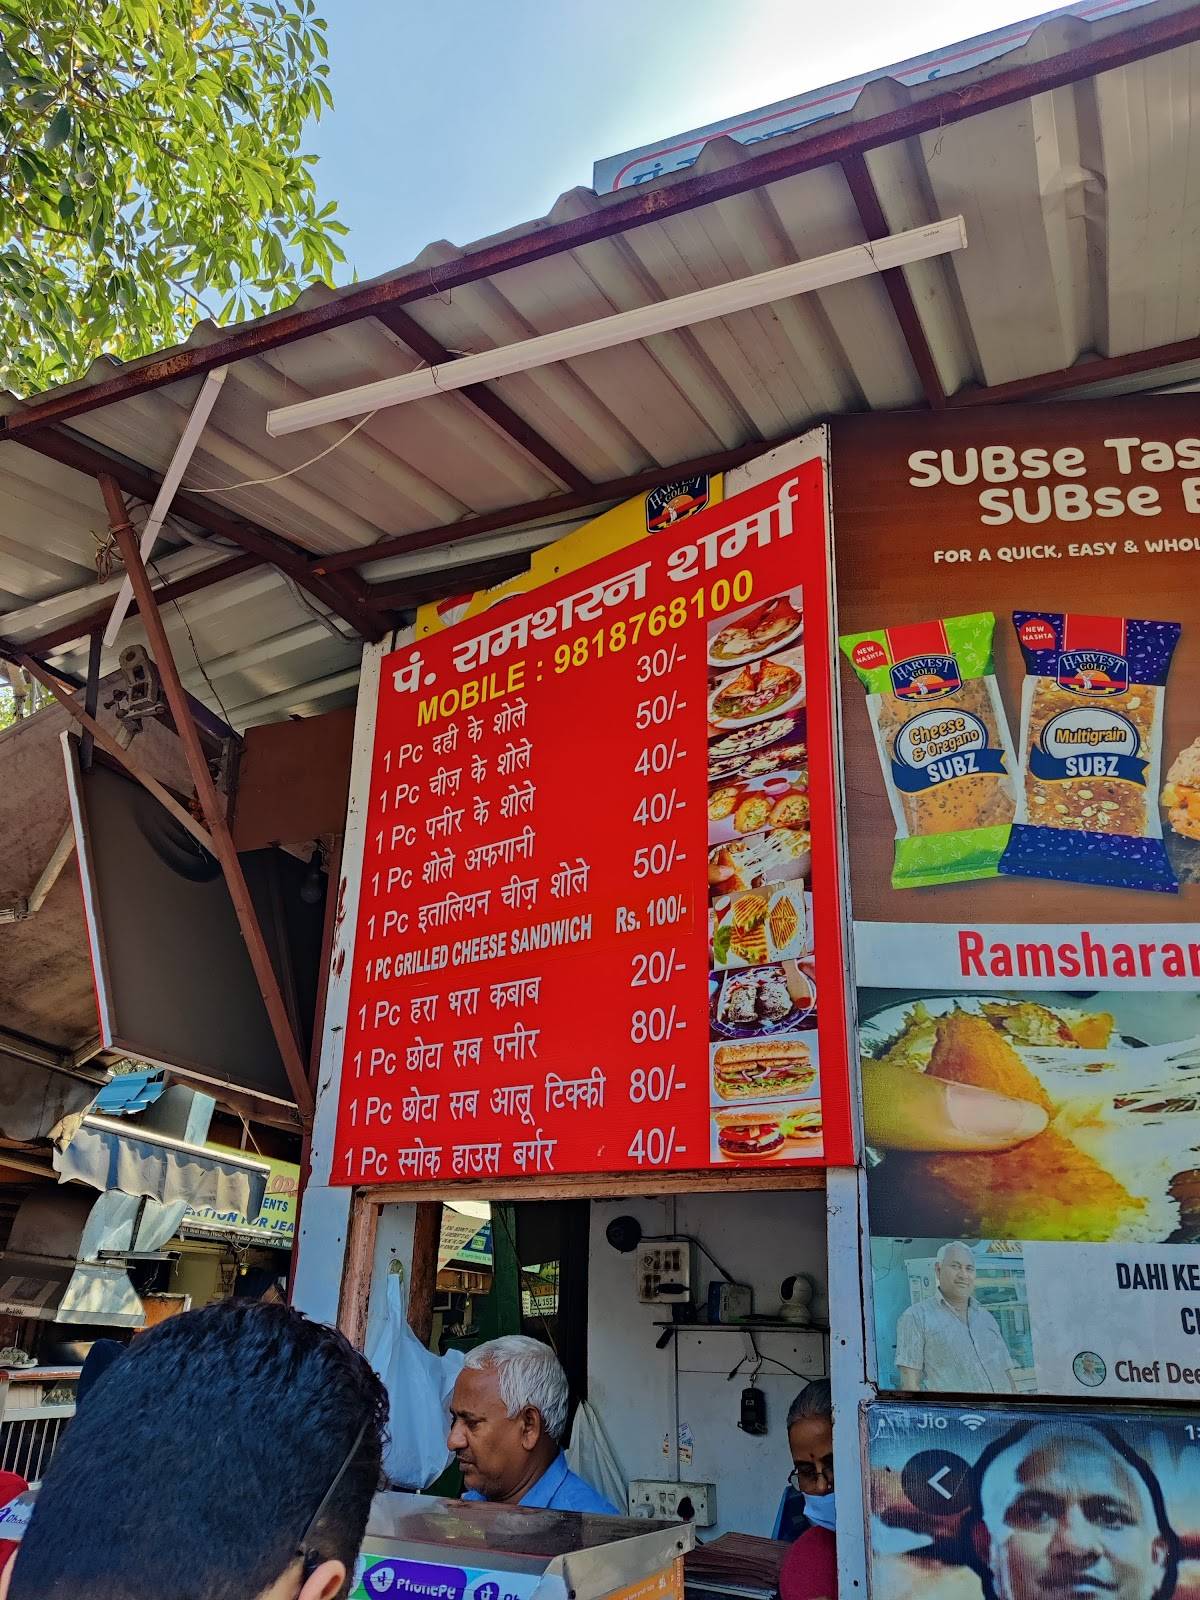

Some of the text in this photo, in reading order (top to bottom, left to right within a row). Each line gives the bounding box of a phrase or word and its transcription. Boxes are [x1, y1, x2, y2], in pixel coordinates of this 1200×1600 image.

[907, 445, 1087, 488] SUBse
[665, 485, 689, 502] GOLD
[978, 483, 1162, 526] SUBse
[933, 549, 972, 564] FOR
[978, 548, 992, 562] A
[997, 545, 1063, 564] QUICK,
[1068, 542, 1118, 558] EASY
[1124, 540, 1139, 553] &
[452, 561, 652, 673] रामशरन
[666, 477, 799, 584] शर्मा
[417, 660, 526, 728] MOBILE
[554, 569, 754, 674] 9818768100
[1022, 631, 1053, 641] NASHTA
[1025, 625, 1045, 633] NEW
[636, 642, 687, 683] 30/-
[855, 650, 885, 664] NASHTA
[856, 645, 875, 656] NEW
[892, 658, 953, 681] HARVEST
[1062, 653, 1125, 675] HARVEST
[1079, 662, 1107, 672] GOLD
[911, 668, 937, 677] GOLD
[635, 689, 687, 730] 50/-
[384, 697, 529, 774] 1 Pc दही के शोले
[908, 717, 965, 745] Cheese
[912, 728, 980, 763] & Oregano
[1055, 727, 1127, 746] Multigrain
[380, 738, 533, 814] 1 Pc चीज़ के शोले
[634, 738, 687, 776] 40/-
[926, 755, 980, 785] SUBZ
[1065, 756, 1120, 777] SUBZ
[375, 780, 537, 854] 1 Pc पनीर के शोले
[632, 788, 687, 827] 40/-
[372, 825, 536, 897] 1 Pc शोले अफगानी
[632, 839, 687, 880] 50/-
[367, 857, 591, 941] 1 Pc इतालियन चीज़ शोले
[614, 894, 687, 934] Rs. 100/-
[365, 913, 592, 983] 1 PC GRILLED CHEESE SANDWICH
[630, 947, 687, 988] 20/-
[358, 976, 542, 1031] 1 Pc हरा भरा कबाब
[630, 1004, 687, 1045] 80/-
[353, 1021, 541, 1079] 1 Pc छोटा सब पनीर
[349, 1066, 607, 1127] 1 Pc छोटा सब आलू टिक्की
[629, 1063, 687, 1104] 80/-
[344, 1147, 354, 1177] 1
[360, 1146, 388, 1177] Pc
[451, 1139, 502, 1175] हाउस
[513, 1127, 558, 1172] बर्गर
[627, 1126, 687, 1165] 40/-
[1115, 1263, 1200, 1291] DAHI KE
[1115, 1360, 1160, 1383] Chef
[917, 1412, 948, 1429] Jio
